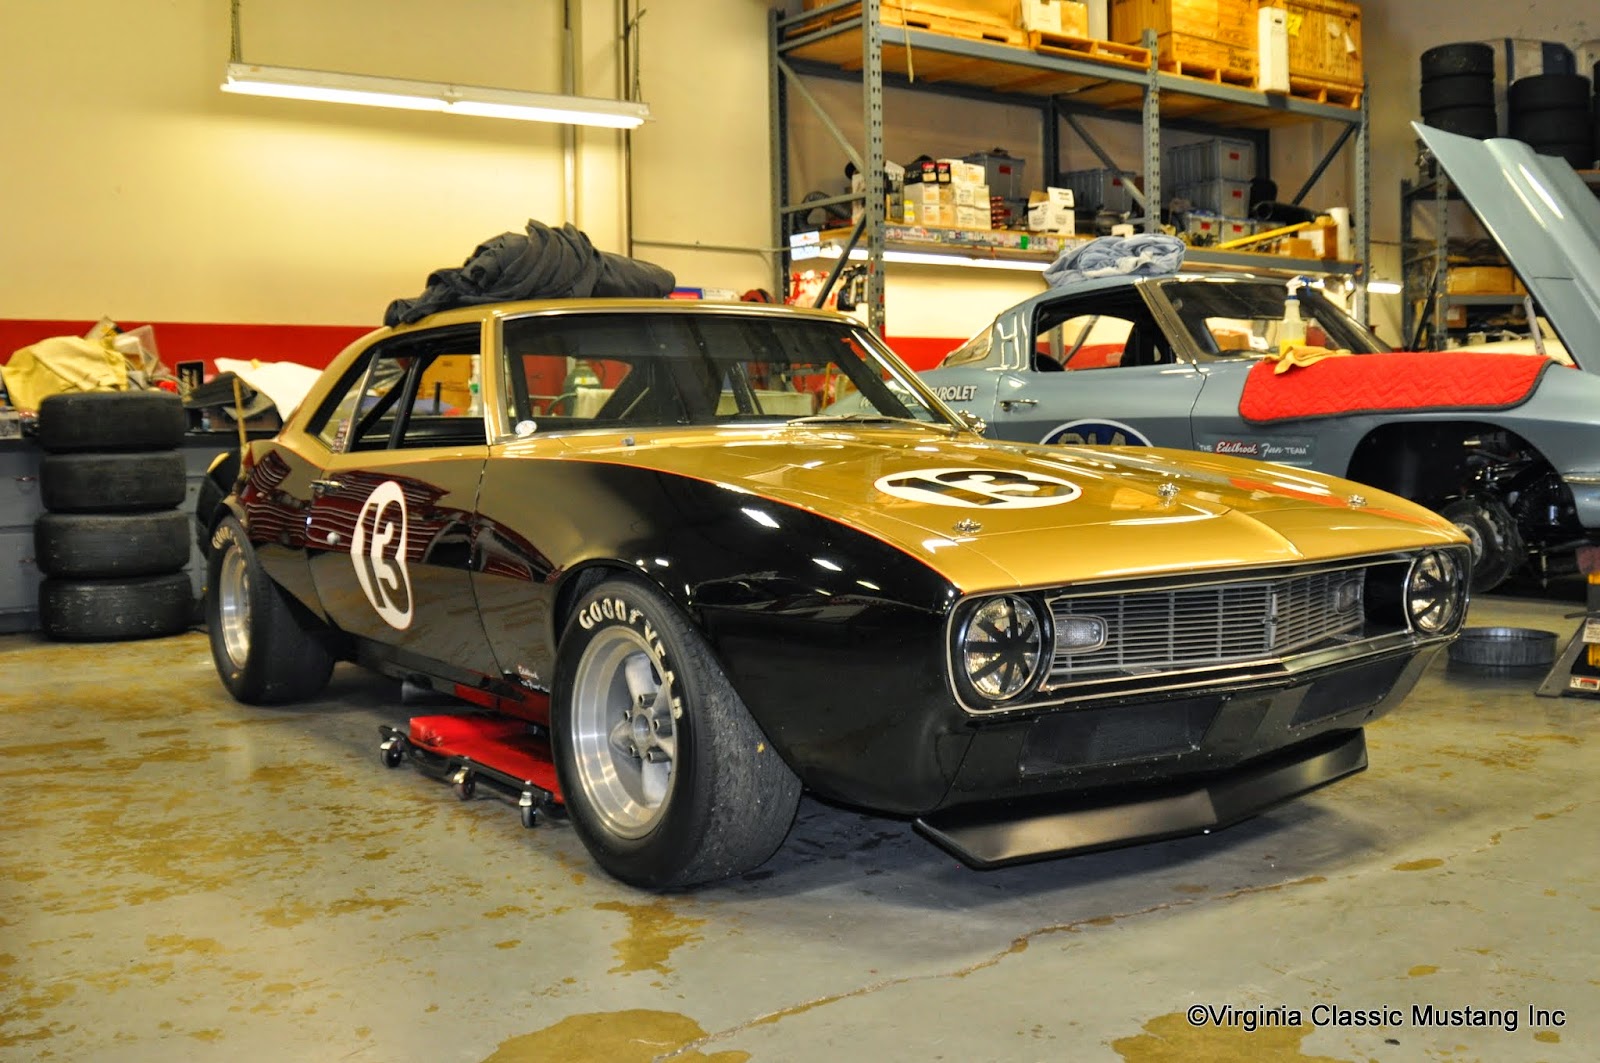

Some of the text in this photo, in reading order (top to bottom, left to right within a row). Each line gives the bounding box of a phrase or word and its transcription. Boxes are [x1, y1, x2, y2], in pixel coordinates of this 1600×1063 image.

[1216, 441, 1258, 455] Edelbrock
[887, 471, 1074, 506] 13
[361, 500, 410, 614] 13
